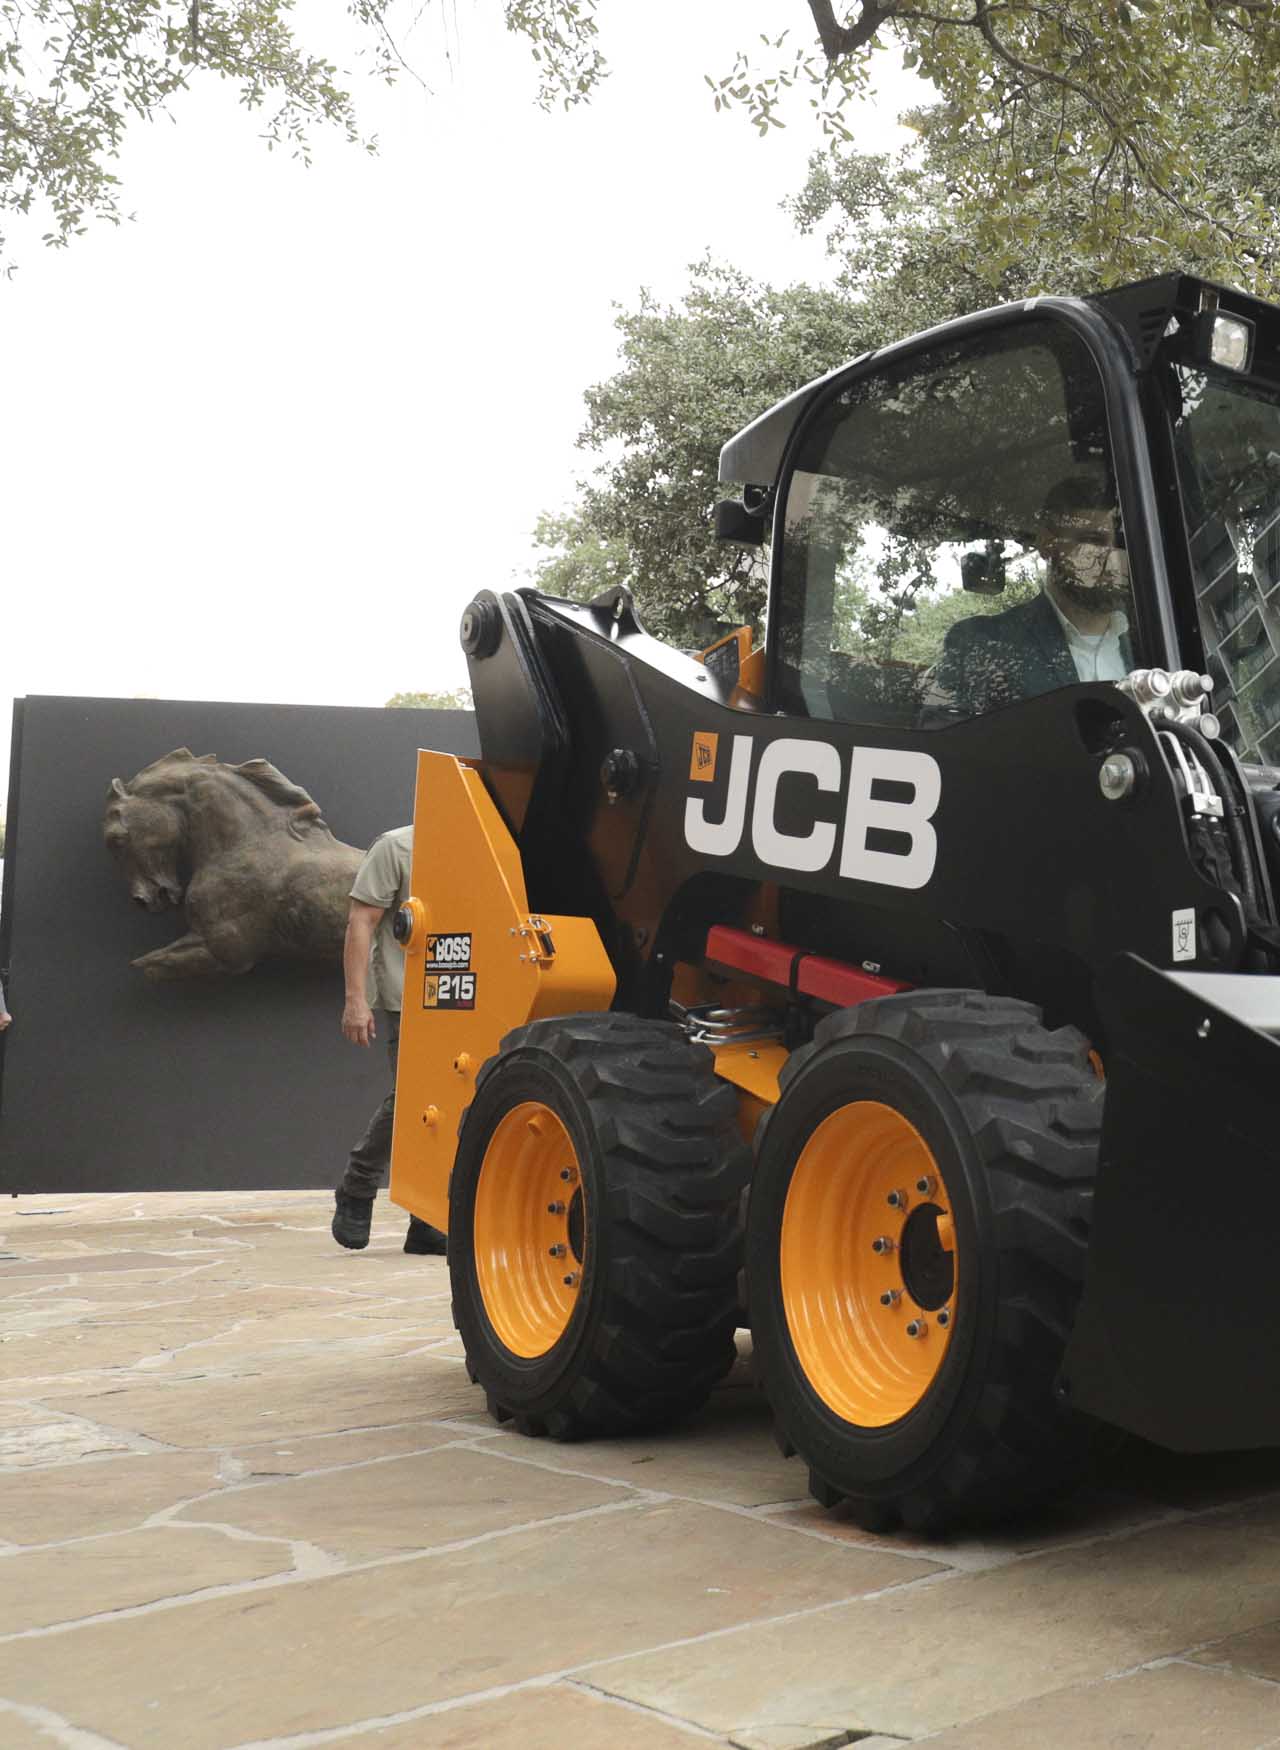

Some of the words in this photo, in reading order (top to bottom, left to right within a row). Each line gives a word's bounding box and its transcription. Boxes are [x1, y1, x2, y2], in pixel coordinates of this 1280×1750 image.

[684, 735, 942, 889] JCB
[435, 936, 471, 961] BOSS
[438, 974, 475, 1000] 215
